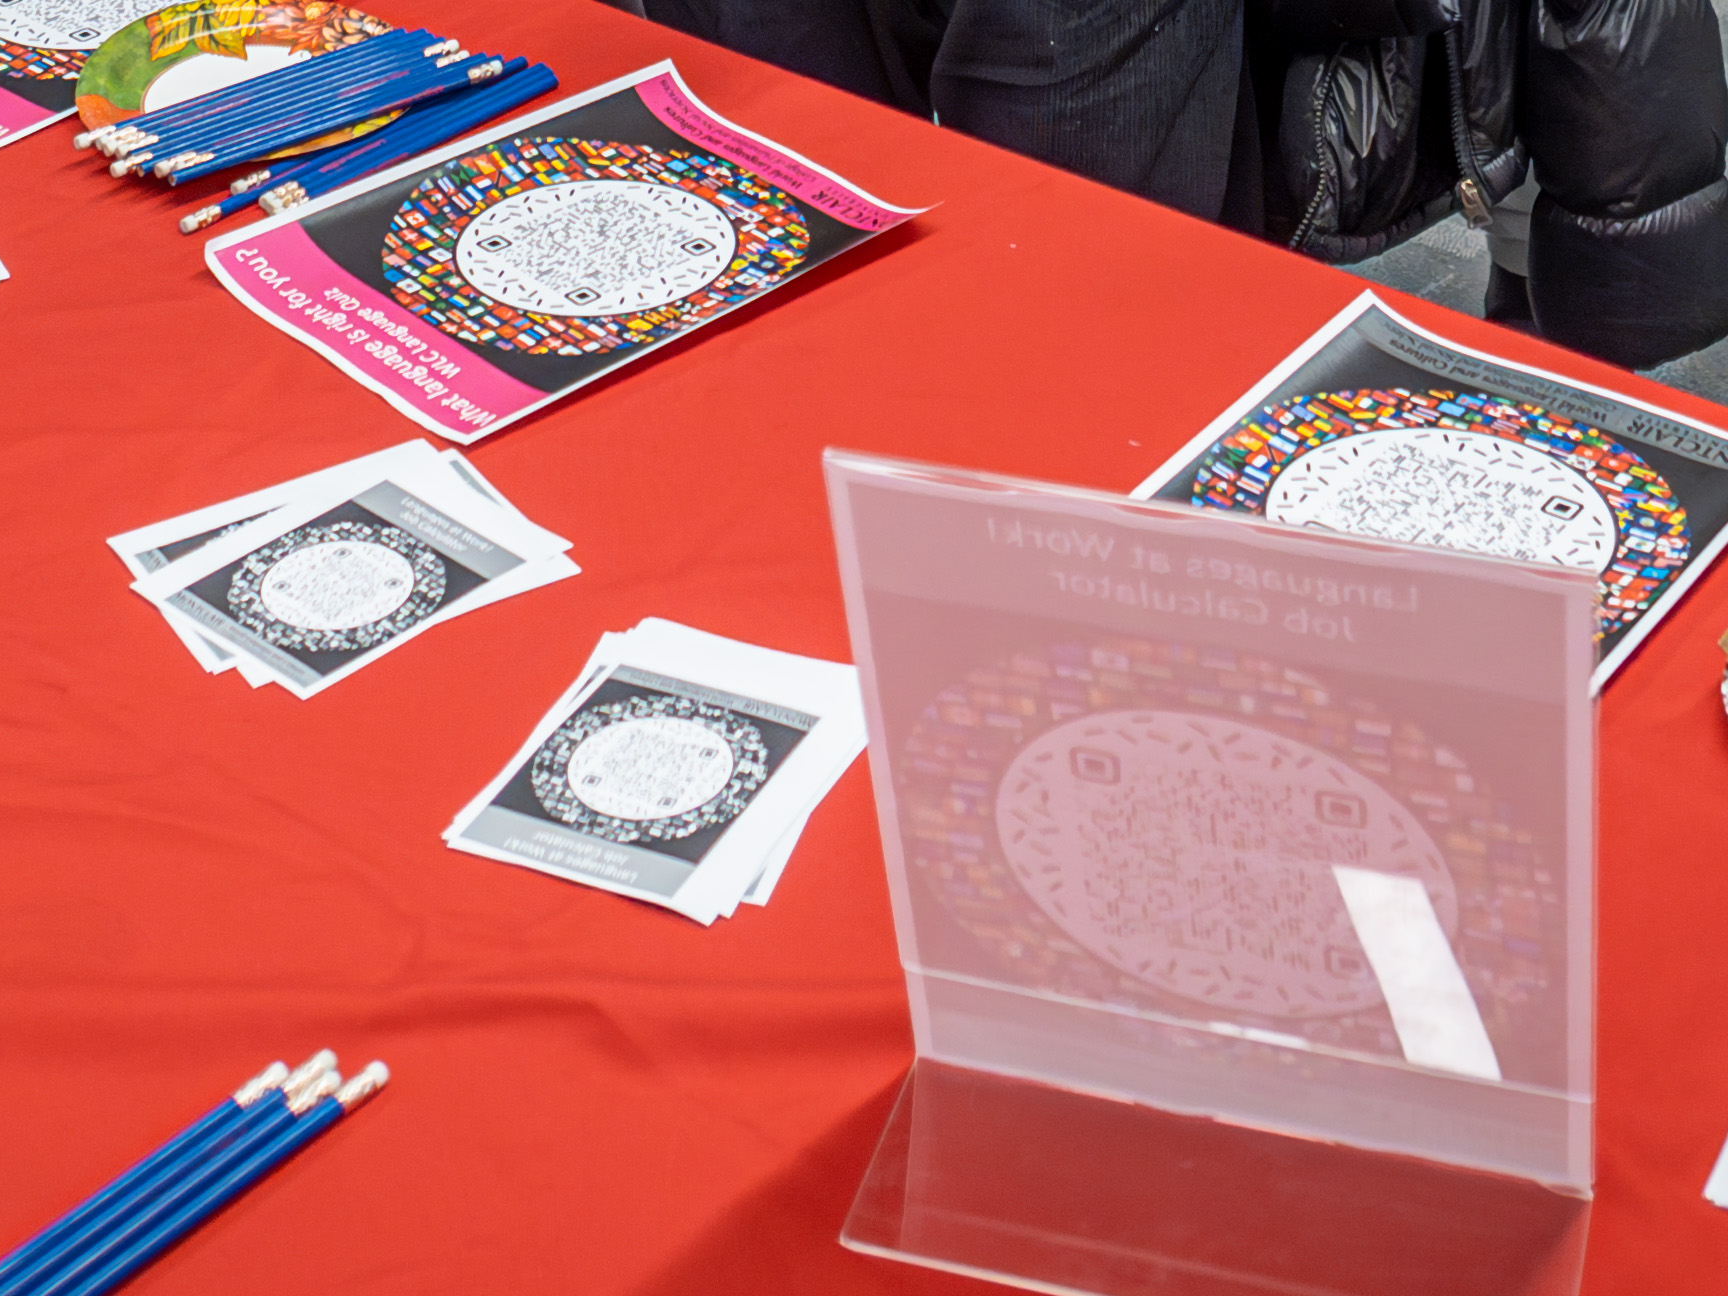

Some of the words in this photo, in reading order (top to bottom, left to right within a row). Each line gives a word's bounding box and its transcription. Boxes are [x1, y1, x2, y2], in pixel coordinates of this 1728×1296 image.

[235, 247, 291, 290] you?
[278, 288, 313, 309] for
[323, 287, 360, 311] Quiz
[304, 304, 354, 333] right
[357, 307, 428, 356] Language
[346, 329, 370, 345] is
[364, 340, 449, 400] language
[418, 349, 461, 379] WLC
[440, 392, 498, 427] What
